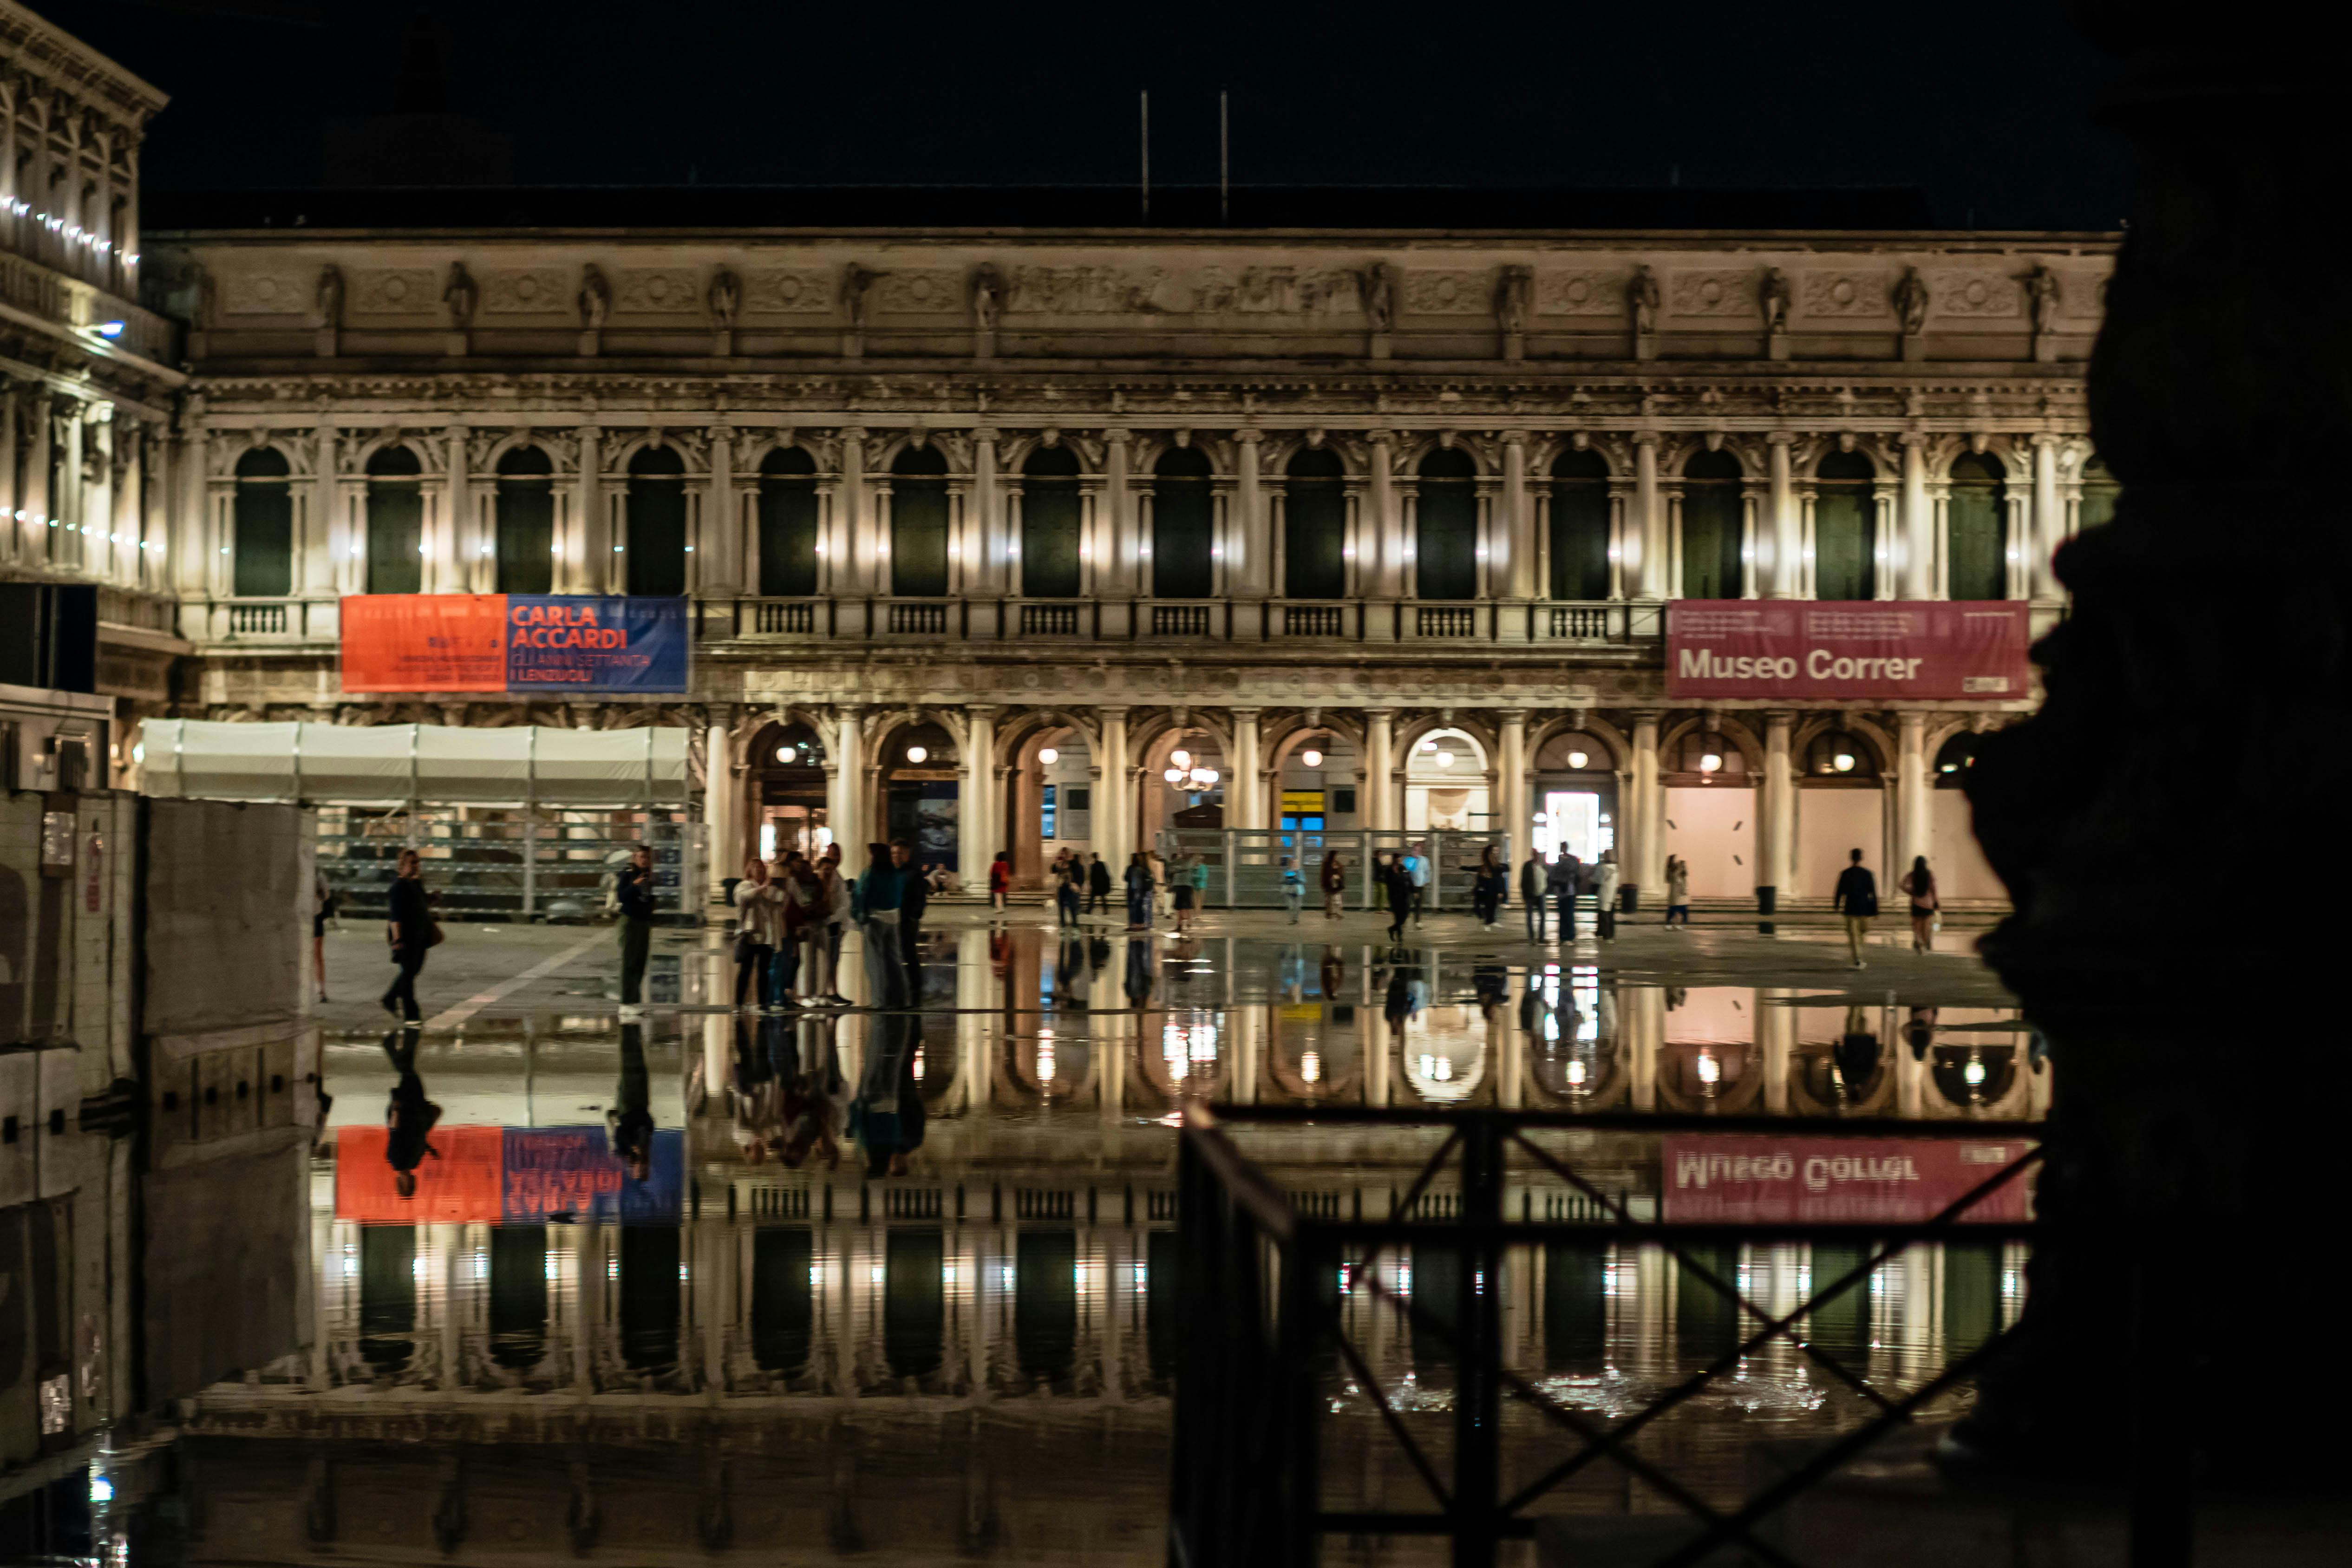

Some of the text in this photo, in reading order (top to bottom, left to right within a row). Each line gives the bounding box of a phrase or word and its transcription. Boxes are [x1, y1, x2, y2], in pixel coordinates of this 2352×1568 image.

[511, 606, 596, 626] CARLA
[511, 628, 627, 649] ACCARDI
[1679, 649, 1923, 680] Museo Correr
